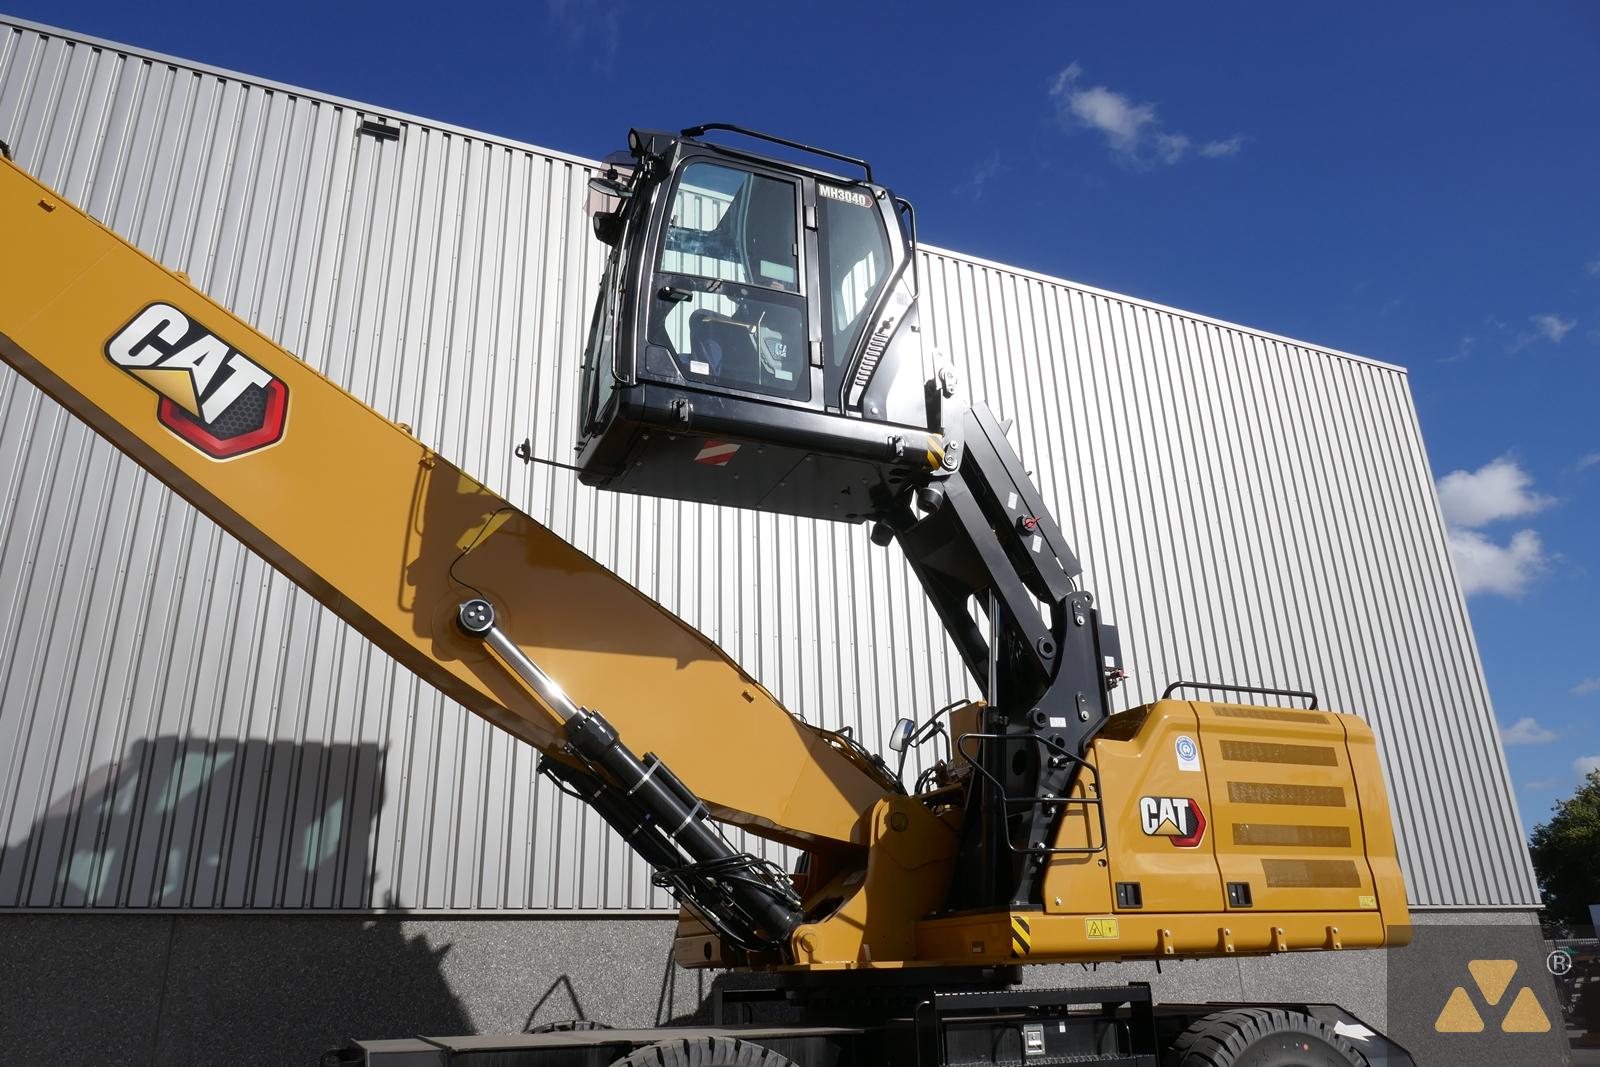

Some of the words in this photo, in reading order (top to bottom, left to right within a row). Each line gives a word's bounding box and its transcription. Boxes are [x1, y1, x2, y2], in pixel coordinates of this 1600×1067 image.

[818, 183, 866, 207] MH3040
[109, 304, 272, 424] CAT
[1140, 797, 1189, 835] CAT
